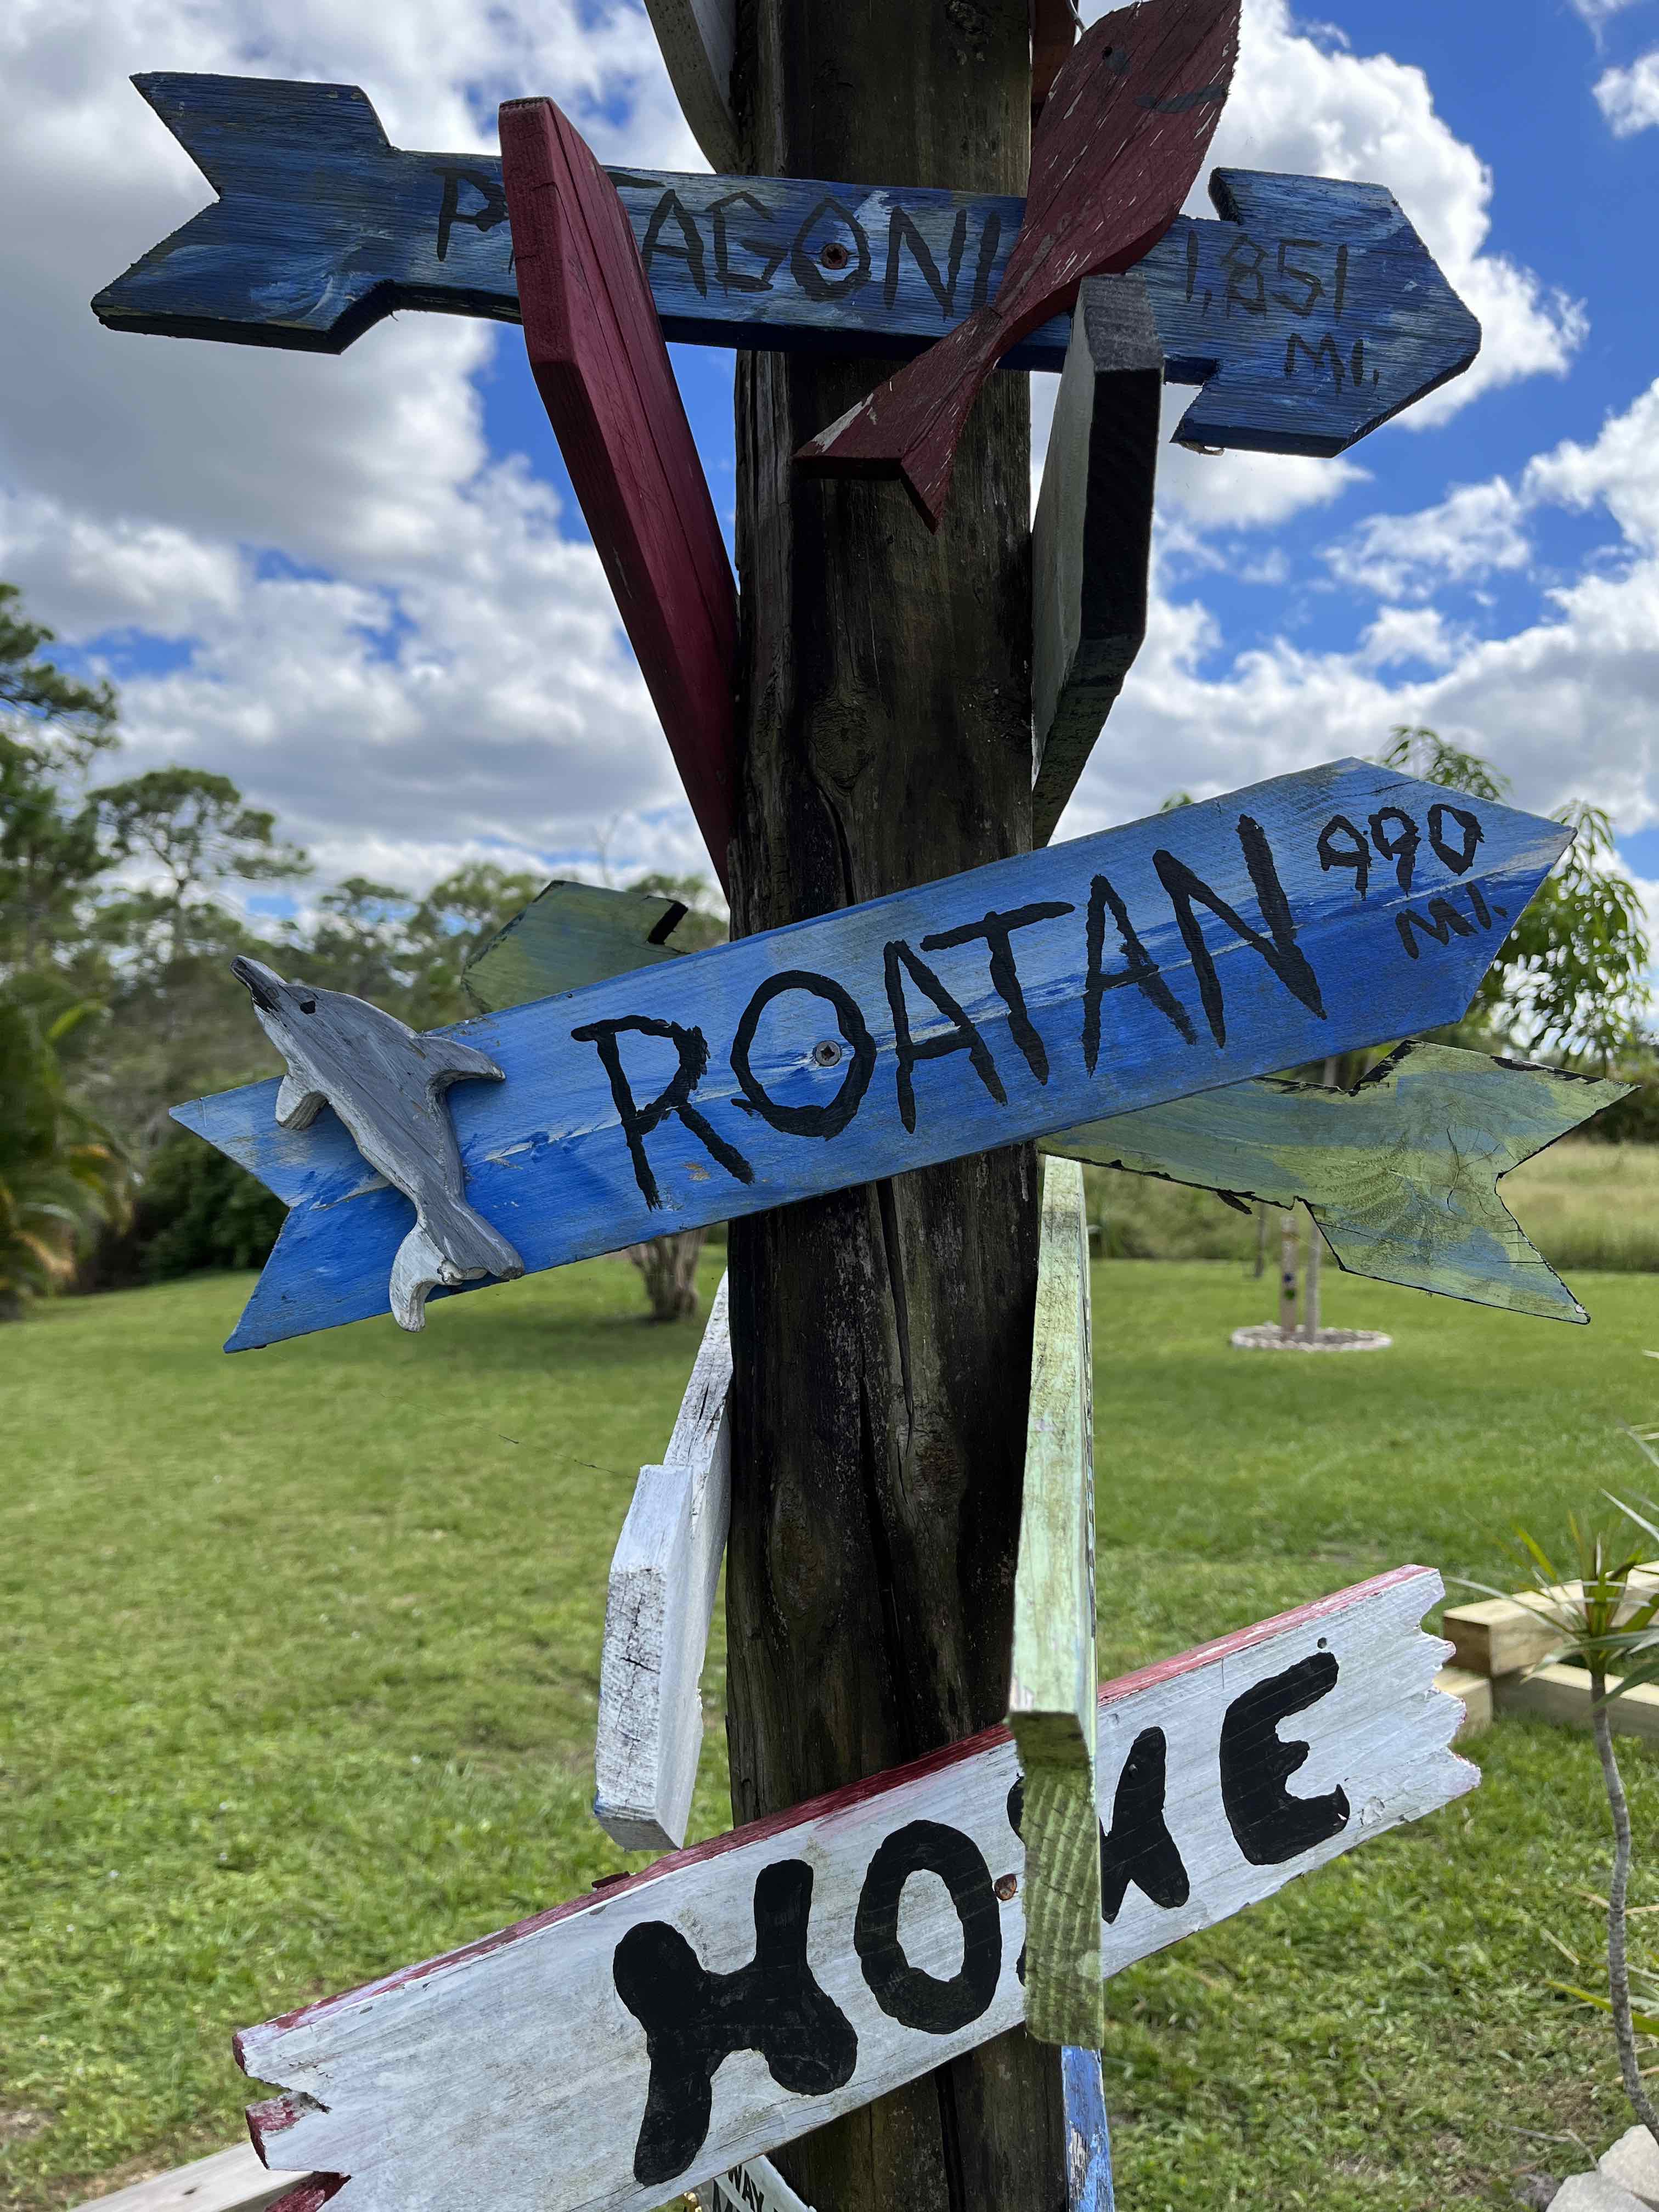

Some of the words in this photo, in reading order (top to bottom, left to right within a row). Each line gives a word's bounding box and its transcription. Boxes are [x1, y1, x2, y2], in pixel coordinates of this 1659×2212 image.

[431, 167, 1001, 323] PAGONI
[1186, 230, 1348, 324] 1,851
[571, 814, 1328, 1212] ROATAN
[1317, 803, 1485, 901] 990
